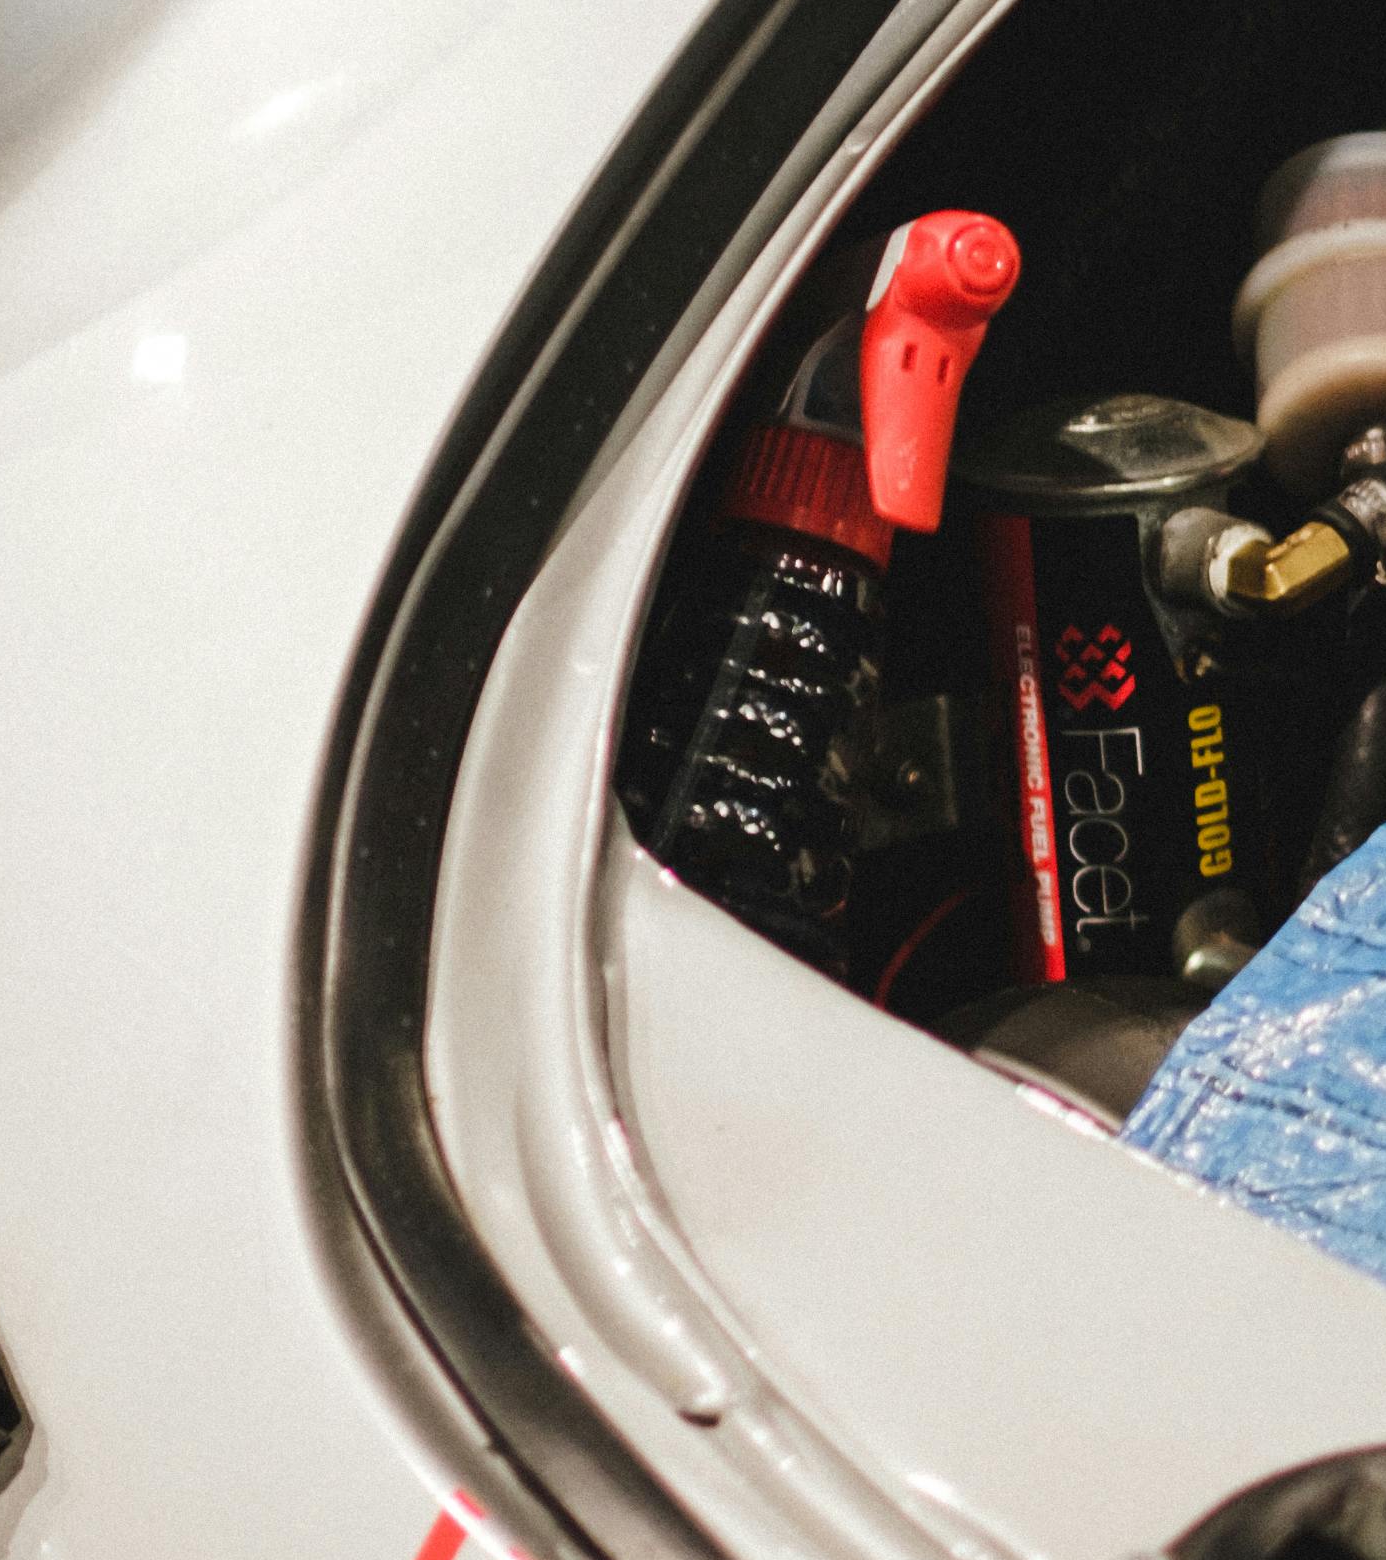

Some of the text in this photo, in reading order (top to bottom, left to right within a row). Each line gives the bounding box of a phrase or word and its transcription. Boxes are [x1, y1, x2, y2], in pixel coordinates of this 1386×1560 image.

[1015, 624, 1045, 791] ELECTRONIC
[1188, 703, 1234, 878] GOLD-FLO
[1028, 795, 1050, 865] FUEL
[1062, 726, 1151, 934] Facet
